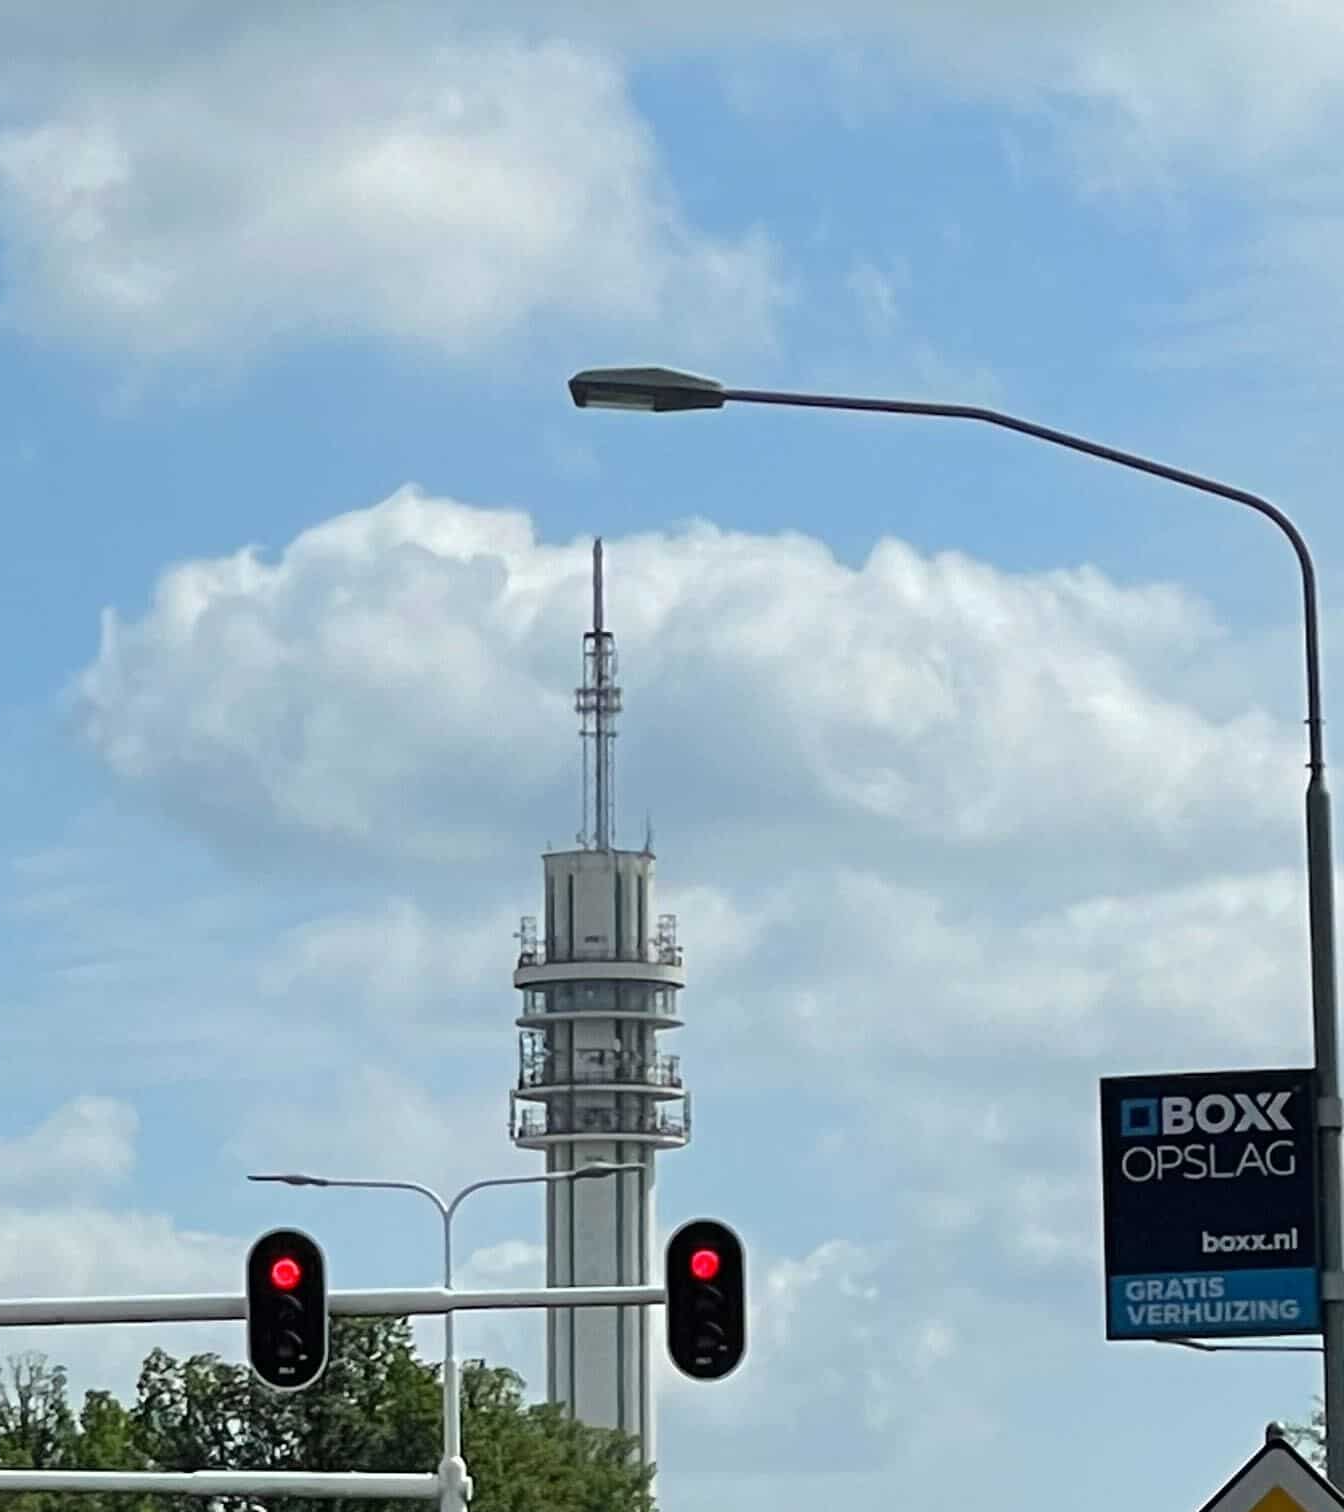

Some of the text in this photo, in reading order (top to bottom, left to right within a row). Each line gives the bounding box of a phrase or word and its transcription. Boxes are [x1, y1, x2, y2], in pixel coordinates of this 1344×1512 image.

[1121, 1140, 1296, 1182] OPSLAG
[1201, 1227, 1299, 1253] boxx.nl
[1125, 1277, 1225, 1301] GRATIS
[1126, 1299, 1301, 1325] VERHUIZING
